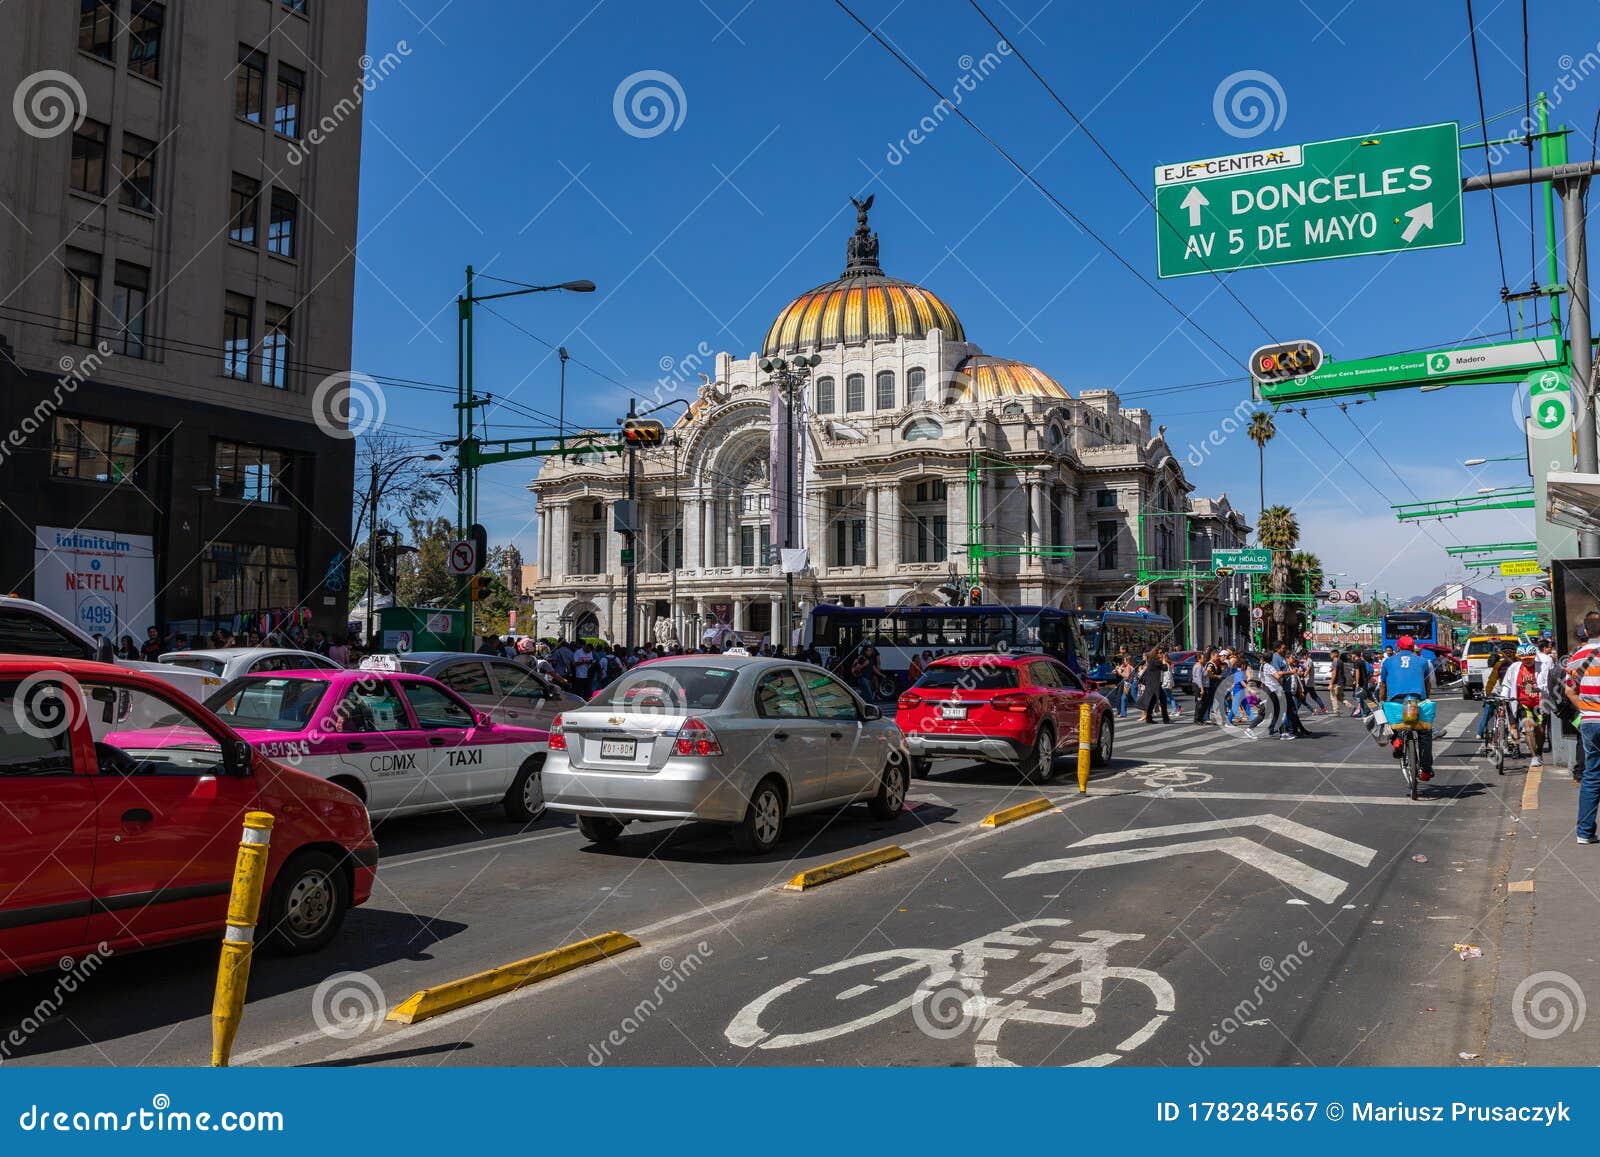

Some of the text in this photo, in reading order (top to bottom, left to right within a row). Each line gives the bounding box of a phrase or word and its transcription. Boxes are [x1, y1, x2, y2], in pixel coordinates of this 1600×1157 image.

[1164, 151, 1290, 181] EJE CENTRAL
[1231, 164, 1433, 215] DONCELES
[1184, 211, 1377, 260] AV 5 DE MAYO
[1455, 354, 1486, 365] Madero
[56, 533, 130, 552] infinitum
[1239, 555, 1267, 563] HIDALGO
[65, 572, 126, 593] NETFLIX
[369, 749, 483, 773] CDMX TAXI
